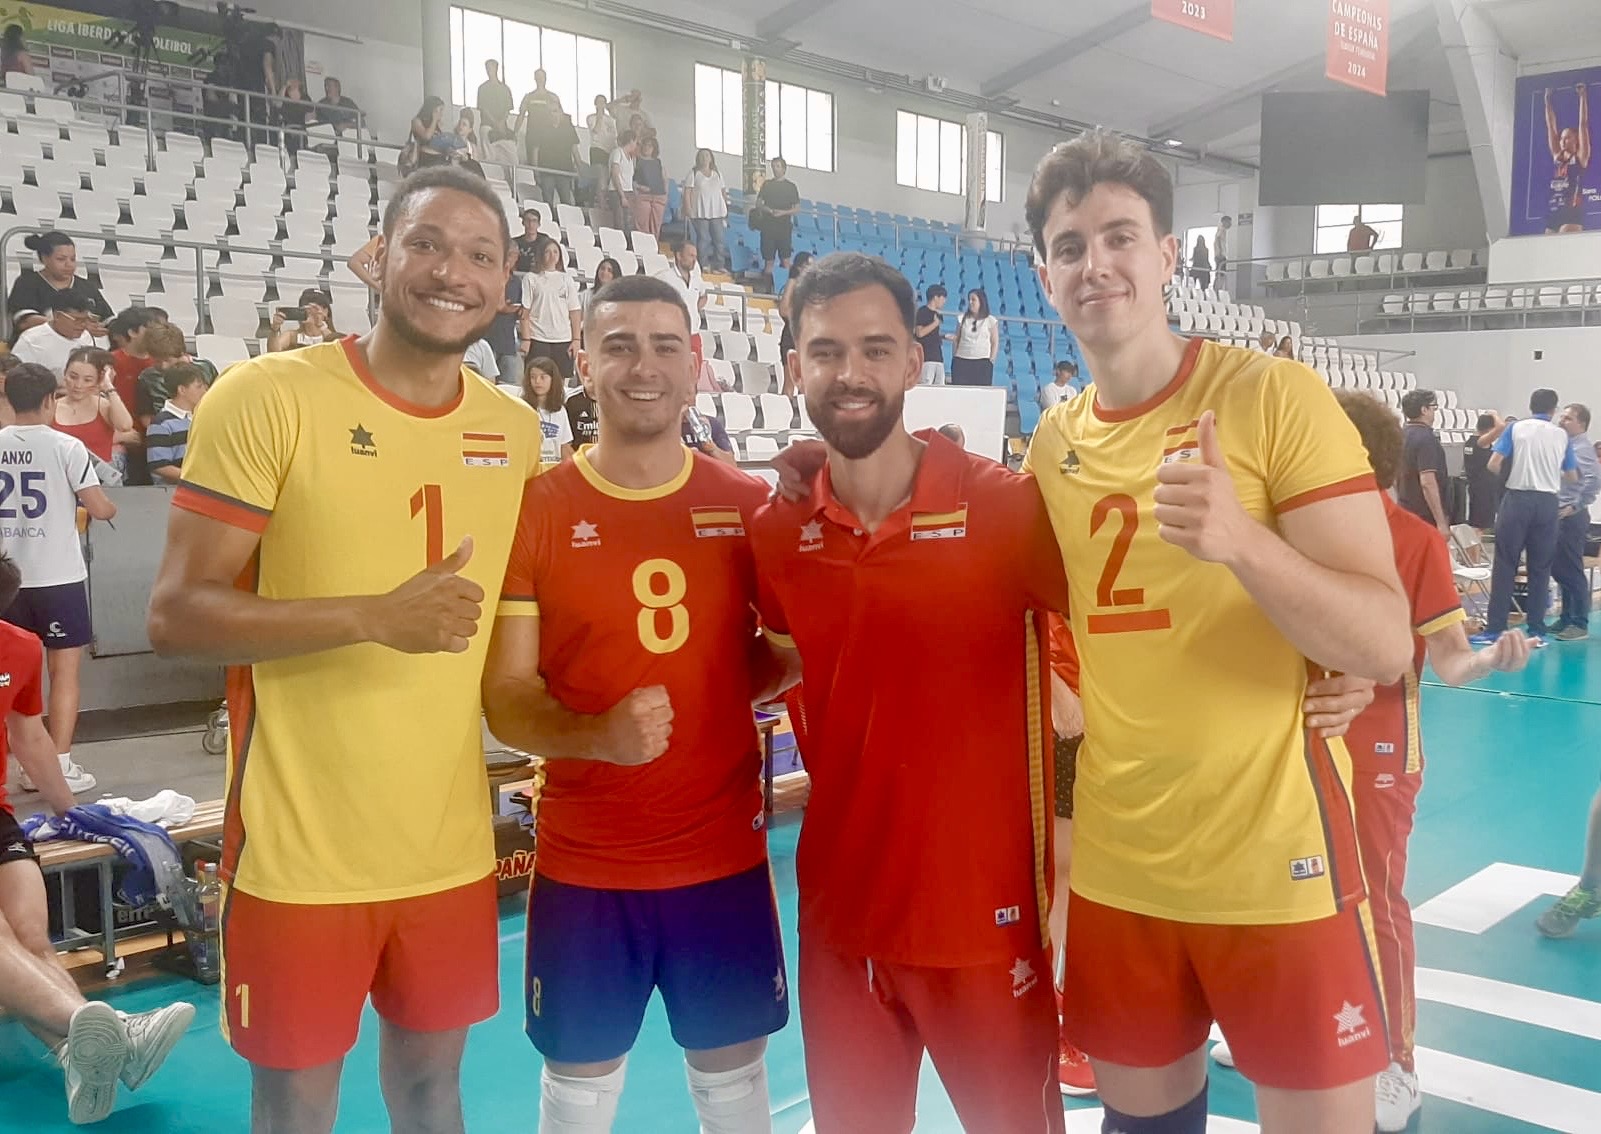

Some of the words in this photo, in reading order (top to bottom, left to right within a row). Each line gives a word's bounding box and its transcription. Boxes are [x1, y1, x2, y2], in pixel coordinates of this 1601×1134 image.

[1181, 1, 1206, 19] 2023
[1332, 0, 1382, 31] CAMPEONAS
[47, 19, 75, 34] LIGA
[1334, 21, 1346, 37] DE
[1348, 25, 1378, 49] ESPAÑA
[1347, 61, 1366, 79] 2024
[1, 450, 33, 465] ANXO
[0, 470, 47, 519] 25
[0, 527, 46, 538] BANCA
[410, 484, 444, 569] 1
[1090, 493, 1145, 607] 2
[632, 558, 690, 654] 8
[235, 983, 249, 1028] 1
[532, 976, 542, 1017] 8
